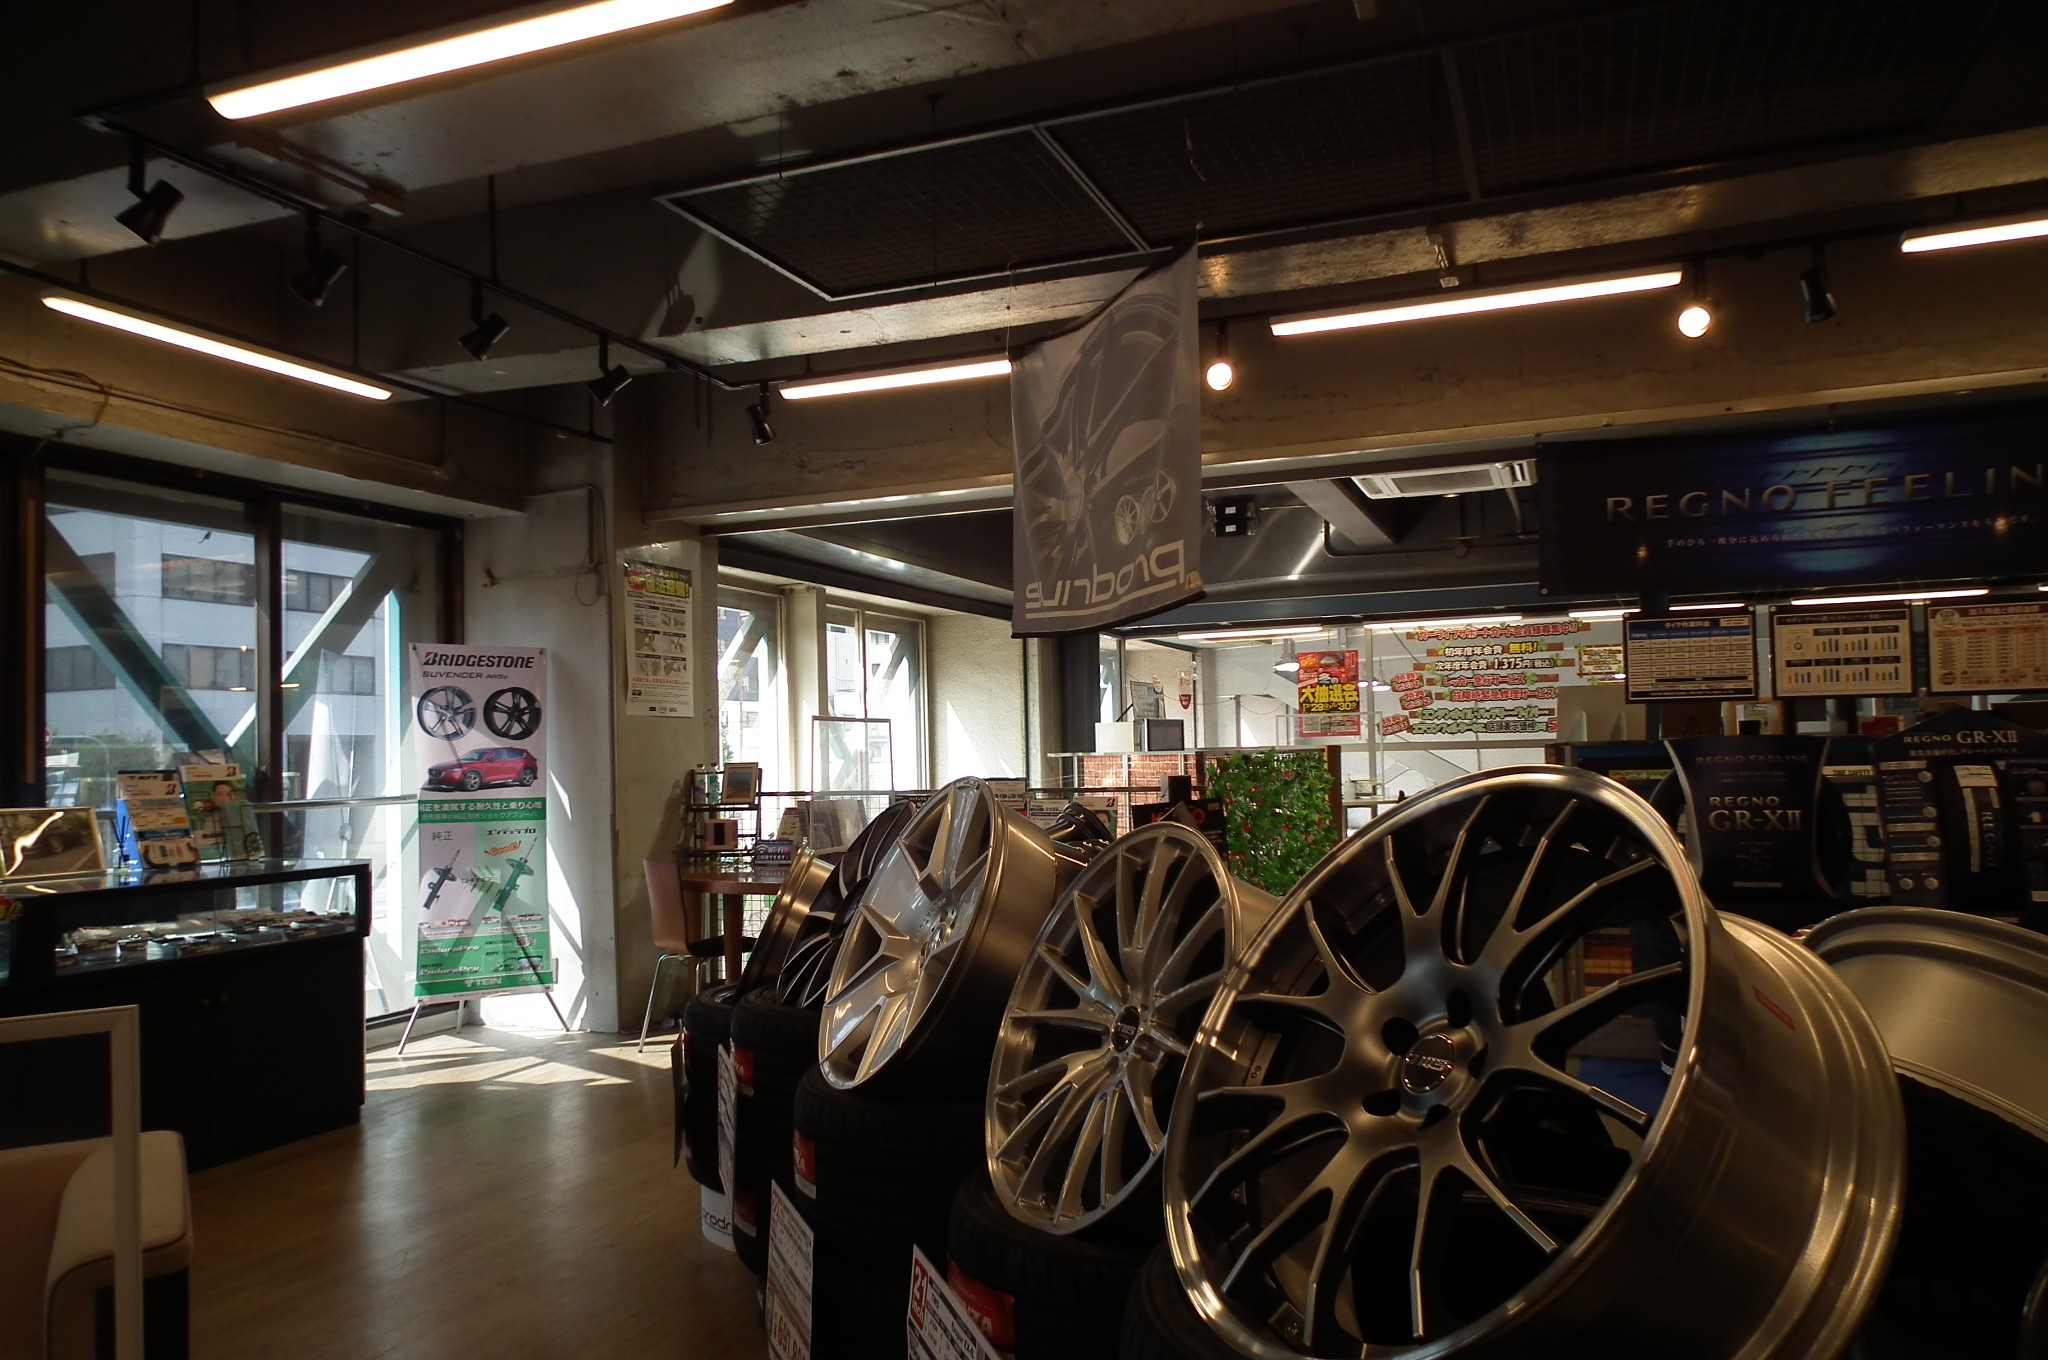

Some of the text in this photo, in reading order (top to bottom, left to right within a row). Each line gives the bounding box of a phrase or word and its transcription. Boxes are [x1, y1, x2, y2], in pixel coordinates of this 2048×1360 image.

[1604, 485, 1797, 523] REGNO
[422, 651, 535, 669] BRIDGESTONE
[1300, 684, 1360, 704] 大抽選会
[1903, 734, 1953, 744] REGNO
[1709, 795, 1781, 808] REGNO
[432, 830, 453, 841] 純正
[912, 1264, 928, 1307] 21
